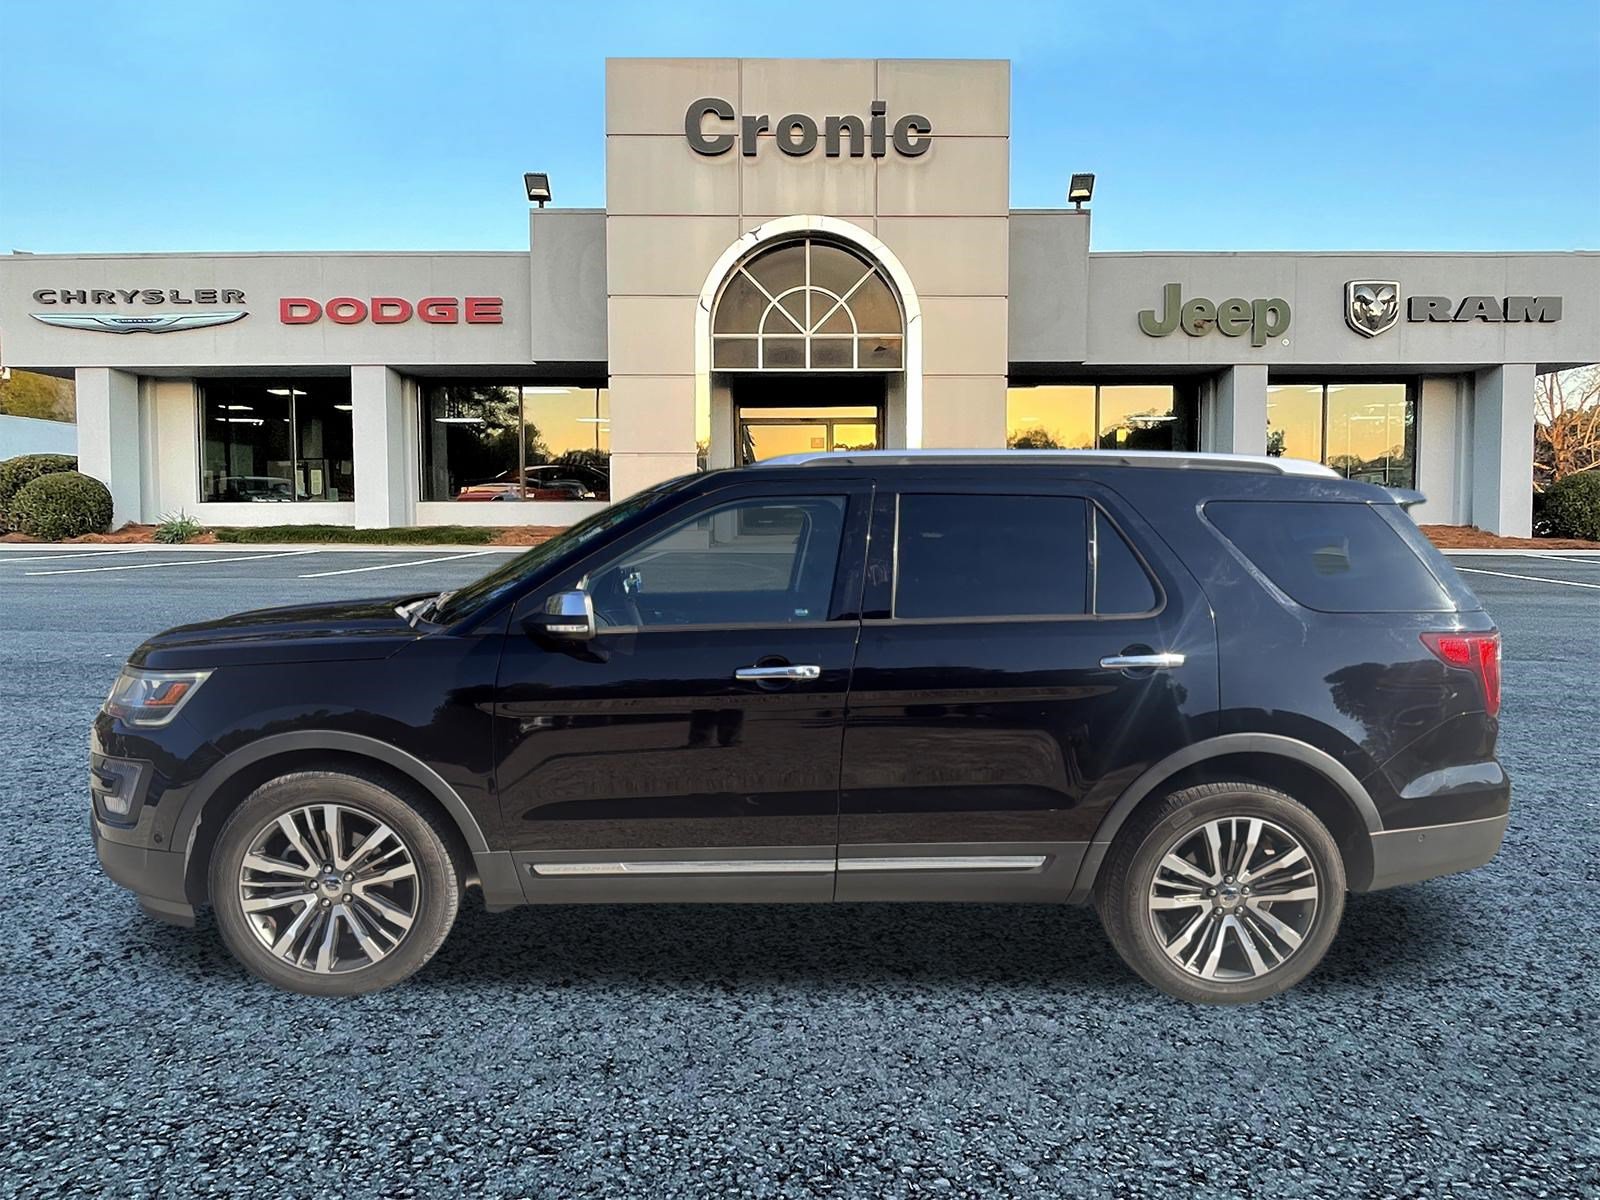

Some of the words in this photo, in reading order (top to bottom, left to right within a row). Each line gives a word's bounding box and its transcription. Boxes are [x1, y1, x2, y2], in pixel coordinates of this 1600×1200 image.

[685, 98, 932, 158] Cronic
[32, 289, 246, 305] CHRYSLER
[280, 297, 503, 325] DODGE
[1407, 296, 1563, 322] RAM
[1138, 283, 1291, 347] Jeep
